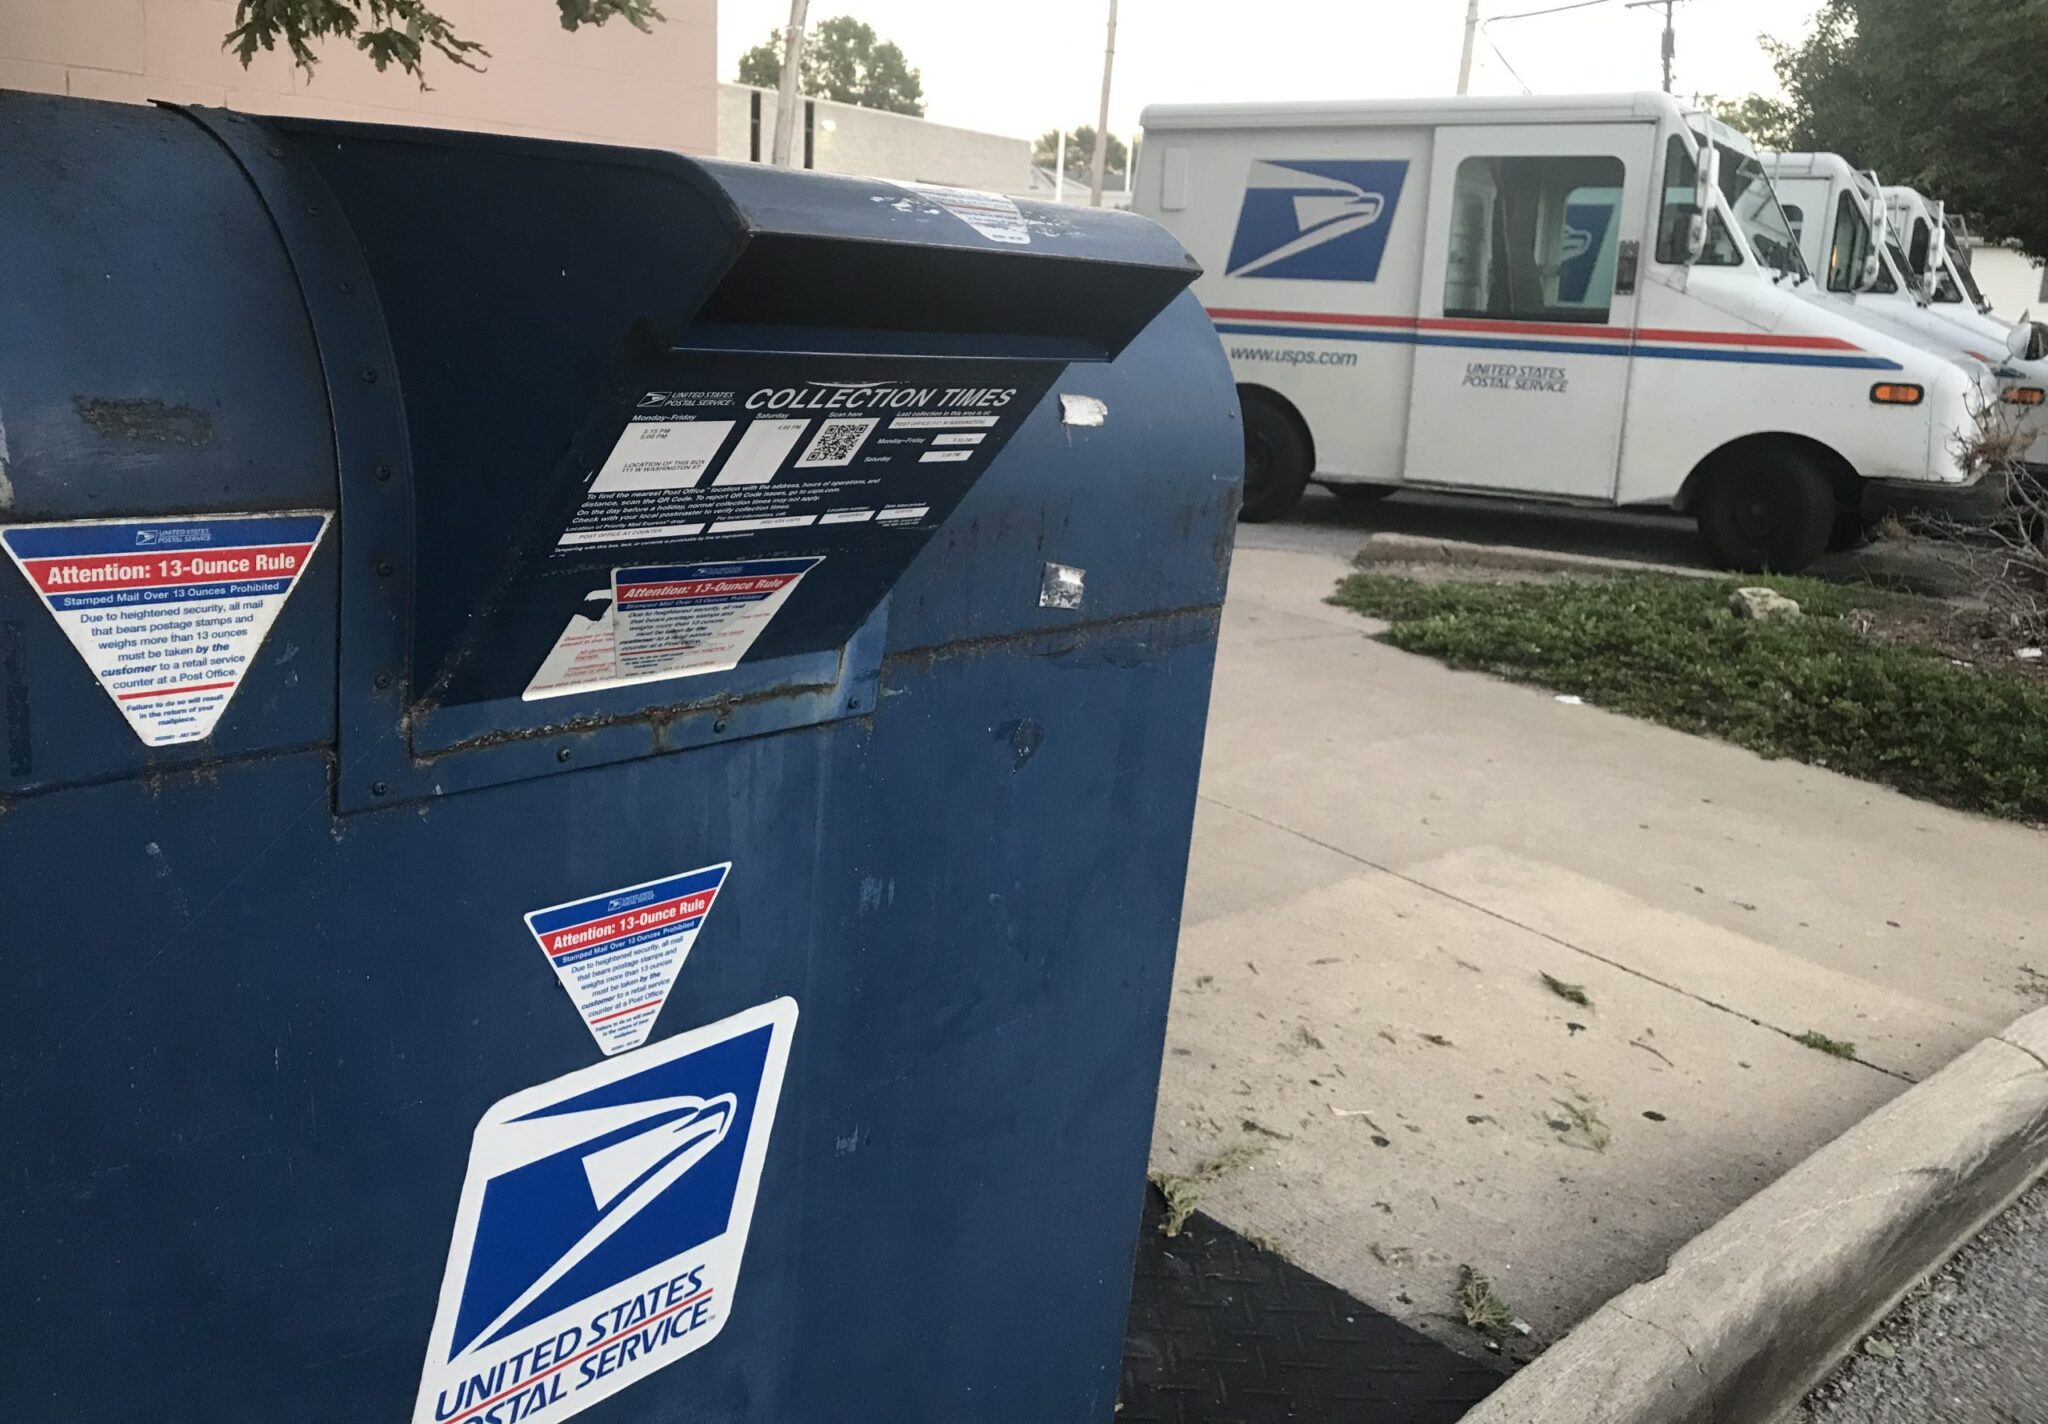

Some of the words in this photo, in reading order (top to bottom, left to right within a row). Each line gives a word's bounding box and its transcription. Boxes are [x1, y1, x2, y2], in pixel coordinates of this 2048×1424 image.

[1230, 348, 1358, 366] www.usps.com
[1467, 362, 1518, 376] UNITED
[1520, 366, 1566, 379] STATES
[1462, 376, 1510, 389] POSTAL
[1514, 380, 1568, 392] SERVICE
[744, 388, 938, 410] COLLECTION
[937, 388, 1017, 408] TIMES
[755, 412, 790, 420] Saturday
[47, 563, 150, 584] Attention:
[158, 558, 249, 577] 13-Ounce
[255, 553, 295, 570] Rule
[64, 594, 113, 606] Stamped
[116, 592, 139, 602] Mail
[143, 591, 169, 600] Over
[173, 589, 185, 597] 13
[187, 587, 226, 596] Ounces
[230, 582, 279, 593] Prohibited
[623, 586, 691, 598] Attention:
[694, 582, 753, 593] 13-Ounce
[754, 580, 783, 588] Rule
[80, 614, 103, 623] Due
[106, 613, 117, 621] to
[120, 606, 180, 620] heightened
[183, 604, 226, 615] security,
[229, 602, 240, 610] all
[242, 599, 263, 609] mail
[91, 626, 113, 636] that
[116, 625, 147, 634] bears
[149, 620, 192, 633] postage
[195, 617, 232, 627] stamps
[234, 614, 253, 623] and
[98, 638, 137, 650] weighs
[140, 636, 168, 645] more
[170, 634, 193, 642] than
[196, 631, 208, 640] 13
[211, 629, 247, 638] ounces
[118, 651, 145, 661] must
[148, 650, 161, 658] be
[164, 647, 193, 656] taken
[195, 645, 209, 654] by
[212, 643, 230, 652] the
[100, 664, 157, 677] customer
[182, 657, 207, 668] retail
[210, 655, 245, 665] service
[112, 678, 154, 689] counter
[156, 676, 167, 684] at
[179, 671, 202, 682] Post
[205, 669, 237, 678] Office.
[202, 694, 223, 702] result
[158, 716, 196, 725] mailpiece.
[163, 708, 187, 716] return
[553, 924, 616, 950] Attention:
[620, 908, 676, 931] 13-Ounce
[680, 899, 705, 915] Rule
[562, 950, 592, 963] Stamped
[593, 945, 608, 954] Mail
[609, 941, 626, 950] Over
[636, 931, 660, 942] Ounces
[663, 921, 694, 934] Prohibited
[571, 965, 585, 974] Due
[595, 950, 632, 966] heightened
[661, 939, 669, 947] all
[670, 935, 683, 944] mail
[577, 972, 590, 982] that
[592, 967, 611, 977] bears
[612, 959, 639, 972] postage
[640, 952, 663, 963] stamps
[664, 947, 677, 956] and
[581, 979, 604, 990] weighs
[606, 973, 623, 983] more
[624, 969, 639, 977] than
[649, 959, 672, 970] ounces
[592, 986, 608, 996] must
[620, 978, 638, 988] taken
[649, 971, 661, 979] the
[581, 995, 615, 1010] customer
[630, 984, 646, 994] retail
[648, 978, 670, 989] service
[588, 1006, 613, 1017] counter
[628, 995, 643, 1005] Post
[435, 1326, 580, 1422] UNITED
[586, 1264, 705, 1347] STATES
[461, 1373, 567, 1424] STAL
[575, 1296, 712, 1390] SERVICE
